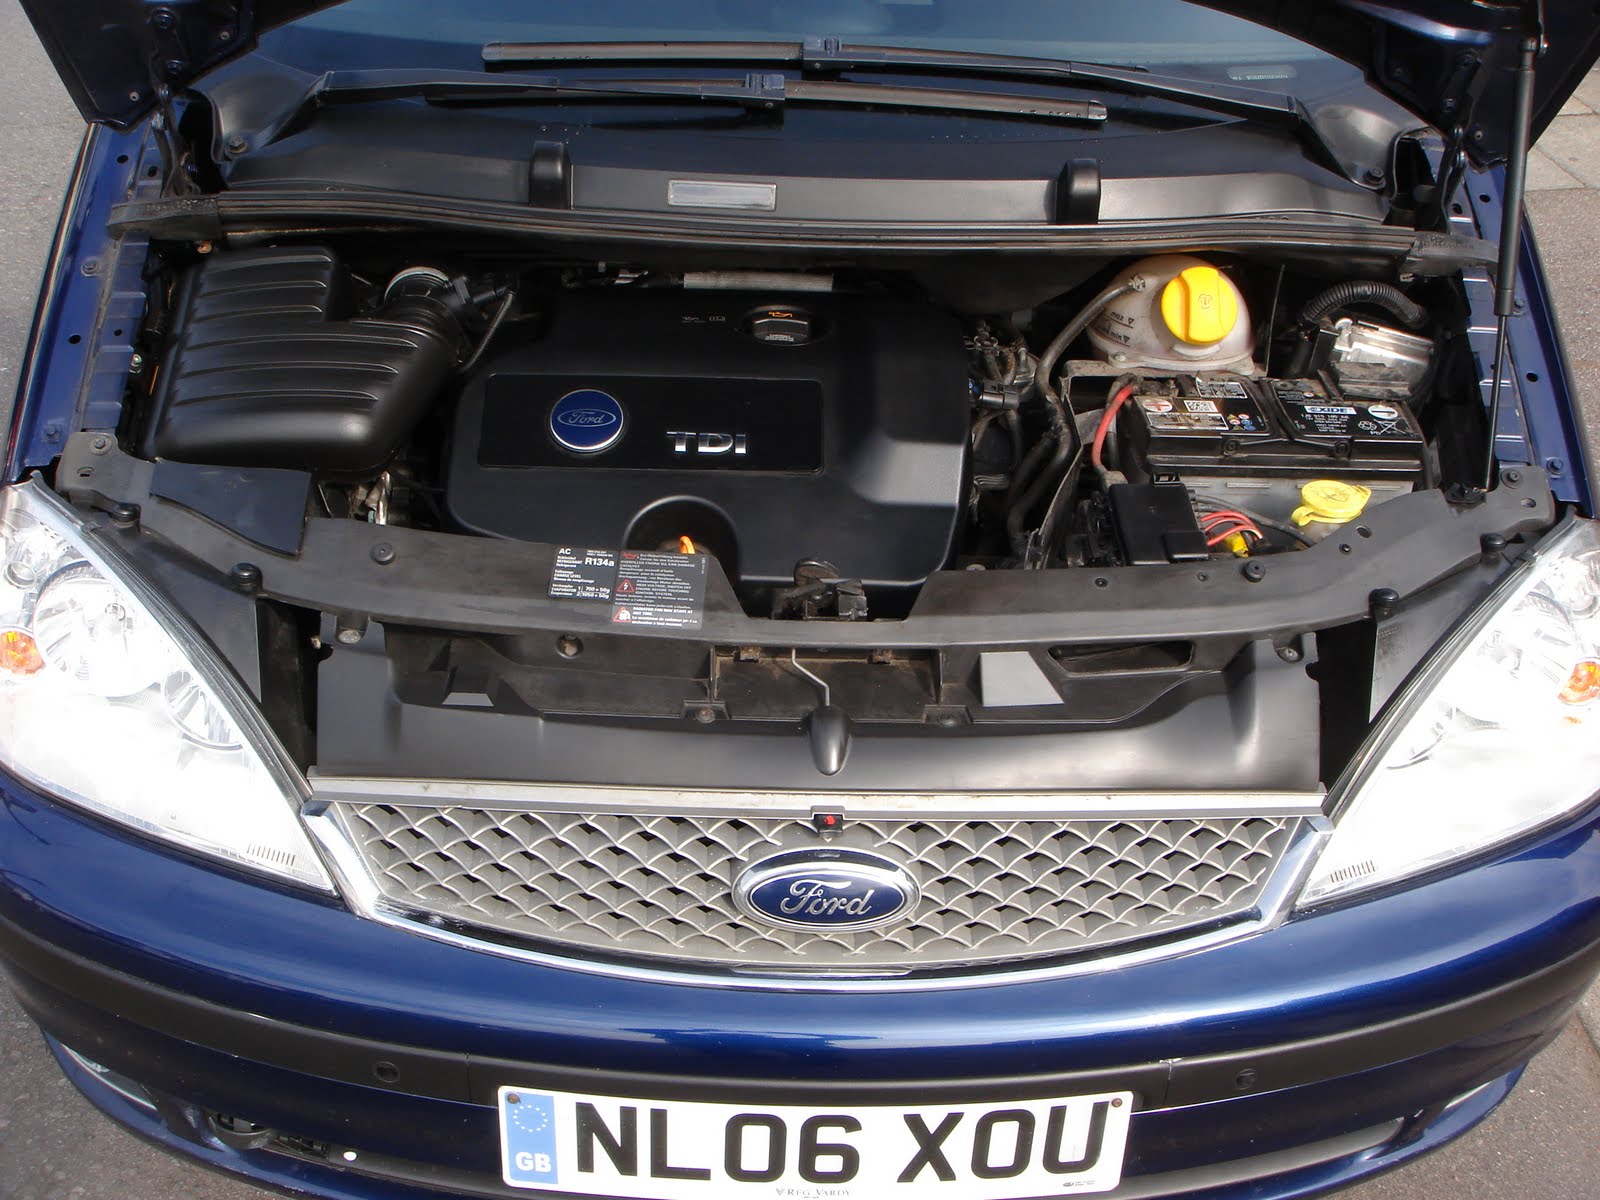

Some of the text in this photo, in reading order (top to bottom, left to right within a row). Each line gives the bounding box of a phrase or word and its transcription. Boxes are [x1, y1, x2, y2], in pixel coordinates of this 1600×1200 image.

[1111, 331, 1122, 341] min
[567, 411, 604, 425] Ford
[666, 431, 746, 454] TDI
[585, 557, 615, 567] R134a
[780, 879, 875, 916] Ford
[575, 1100, 1110, 1185] NL06 XOU
[515, 1151, 552, 1173] GB
